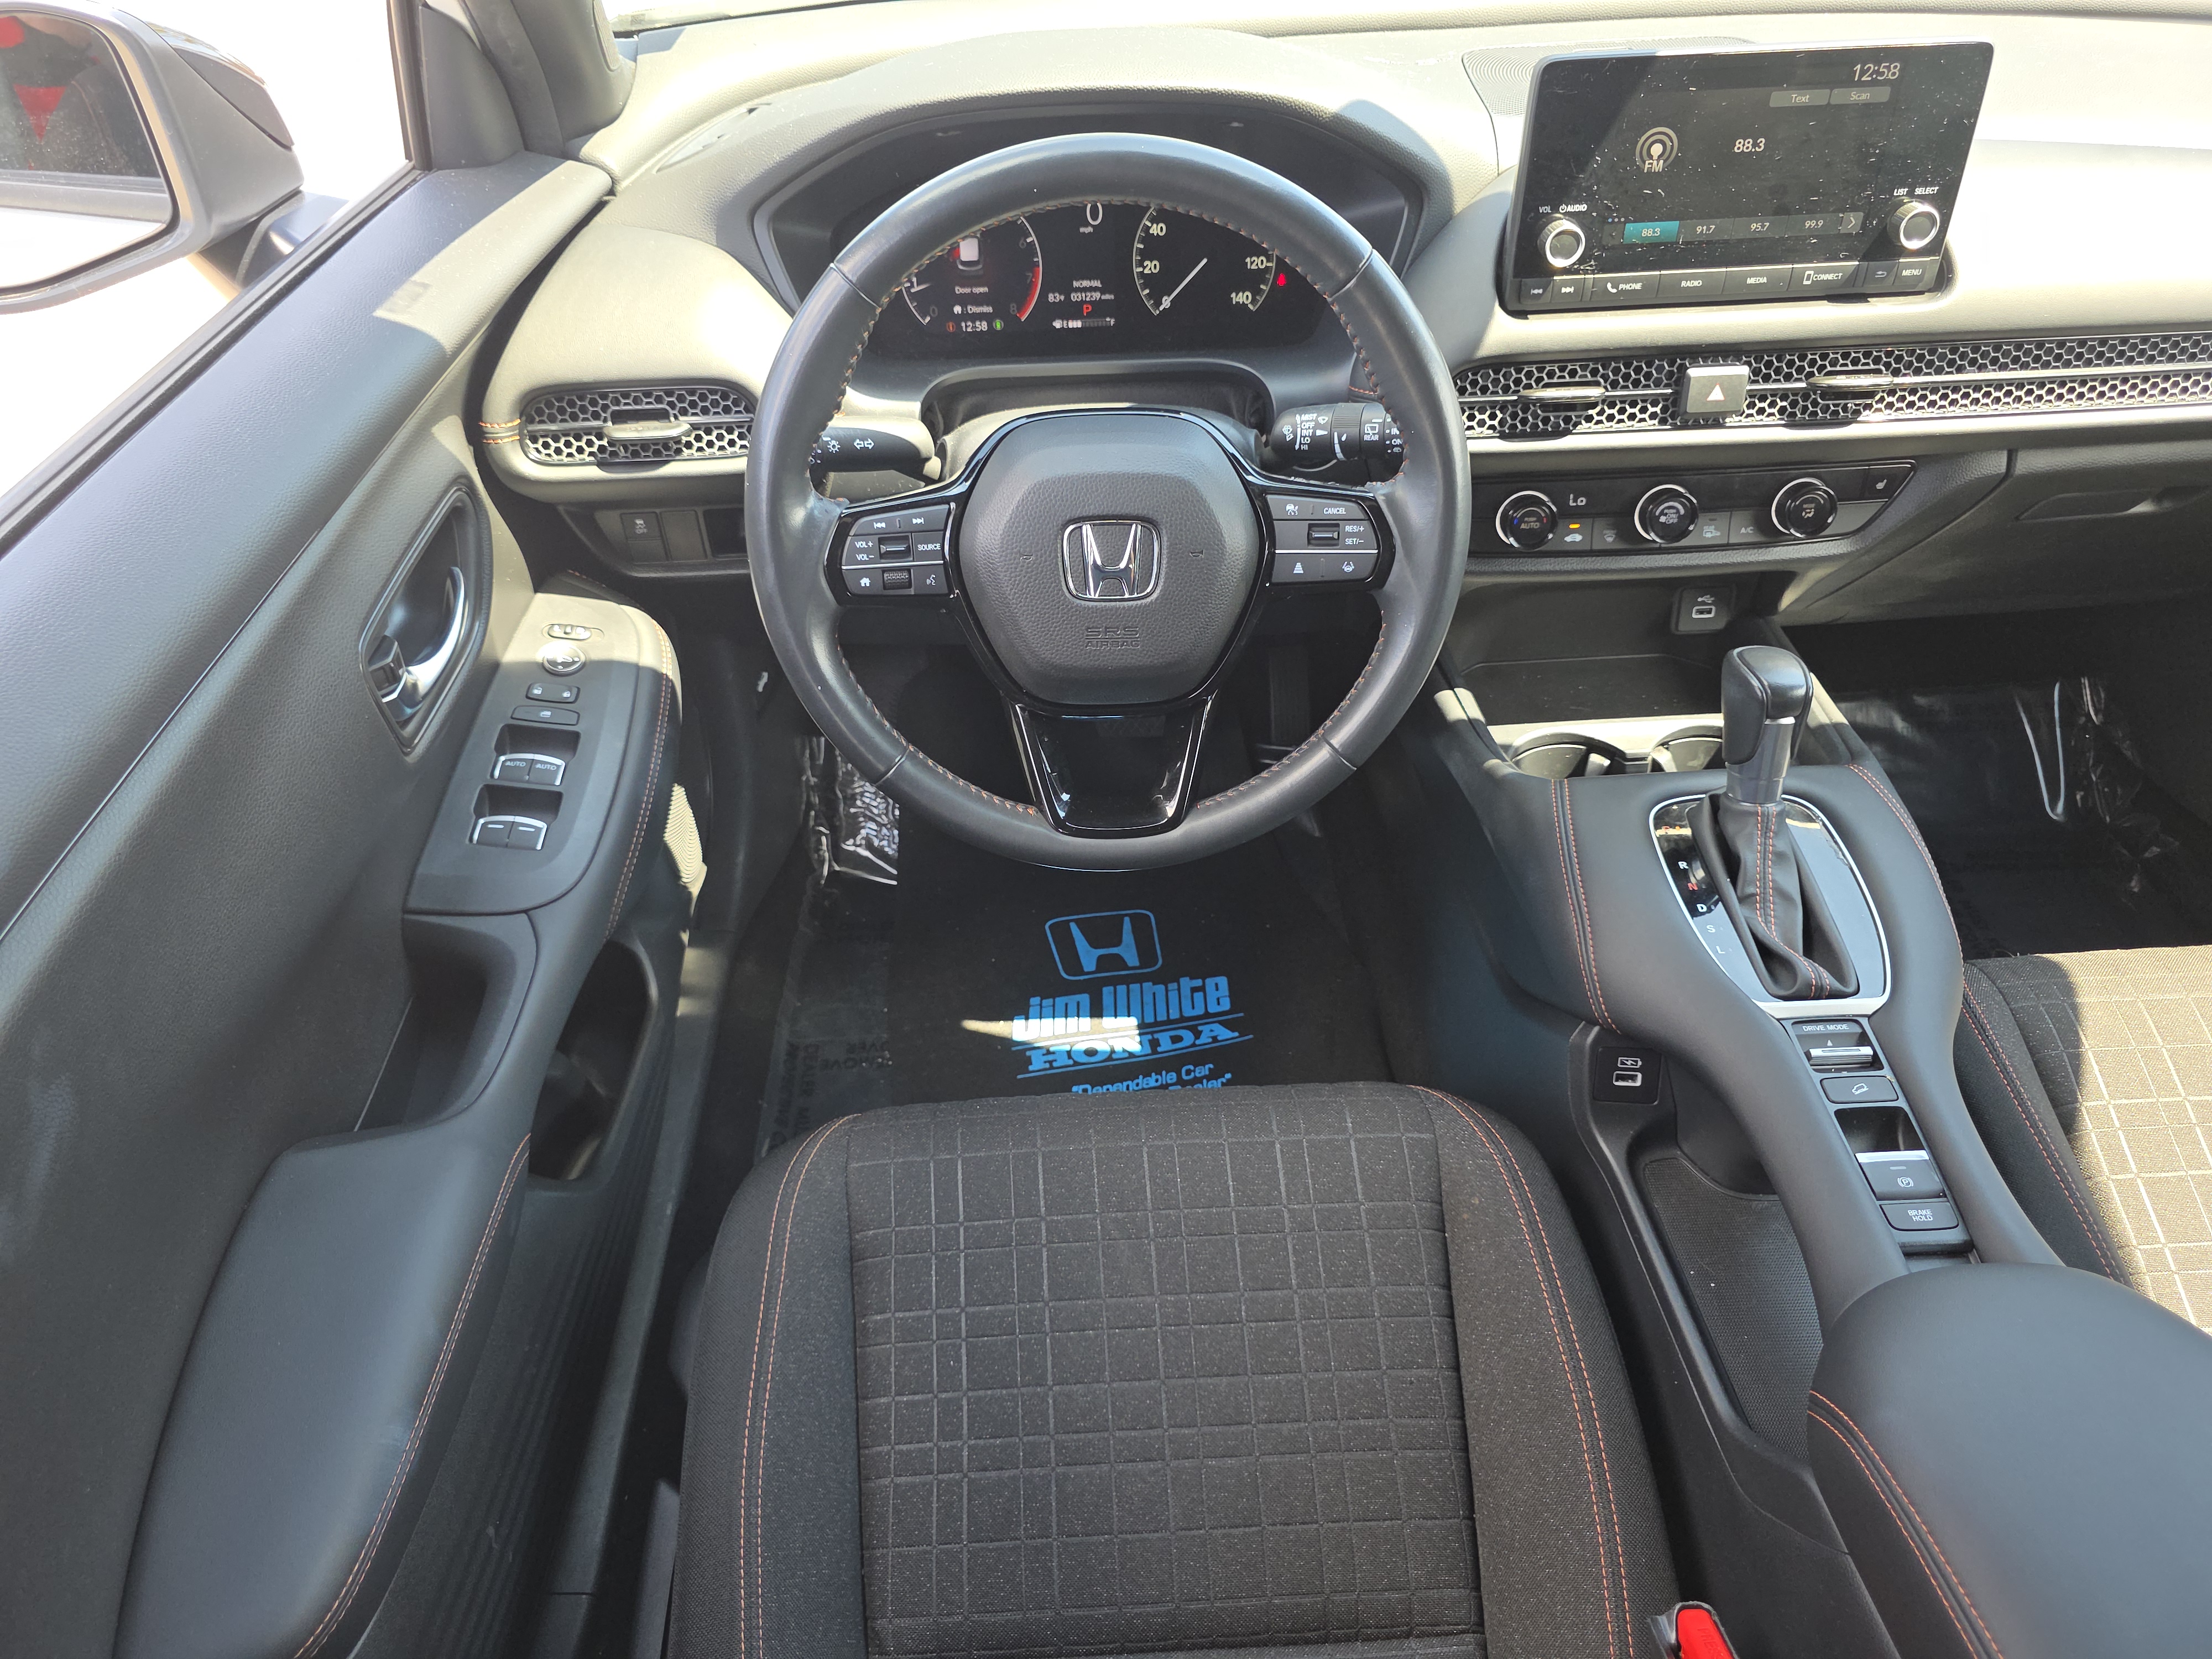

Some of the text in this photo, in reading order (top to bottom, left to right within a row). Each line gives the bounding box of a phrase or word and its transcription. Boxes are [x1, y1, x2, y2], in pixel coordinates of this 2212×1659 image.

[1853, 62, 1900, 81] 12:58
[1791, 94, 1809, 103] Text
[1850, 91, 1870, 101] Scan
[1734, 138, 1765, 153] 88.3
[1644, 159, 1664, 173] FM
[1566, 204, 1587, 212] AUDIO
[1150, 223, 1166, 236] 40
[1696, 225, 1715, 234] 91.7
[1750, 222, 1770, 232] 95.7
[1805, 220, 1823, 229] 99.9
[1641, 228, 1660, 237] 88.3
[1144, 260, 1160, 274] 20
[1245, 256, 1266, 269] 120
[1073, 279, 1102, 288] NORMAL
[1619, 283, 1642, 291] PHONE
[955, 285, 971, 294] Door
[1071, 291, 1100, 301] 031239
[1230, 291, 1251, 305] 140
[968, 305, 993, 314] Dismiss
[1083, 304, 1092, 316] P
[961, 321, 988, 332] 12:58
[1085, 627, 1140, 638] SRS
[1085, 639, 1140, 649] AIRBAG
[1697, 904, 1707, 912] D
[1707, 925, 1715, 933] S
[1717, 946, 1725, 954] L
[1102, 976, 1231, 1030] White
[1026, 1022, 1239, 1071] HONDA
[1181, 1063, 1214, 1080] Car
